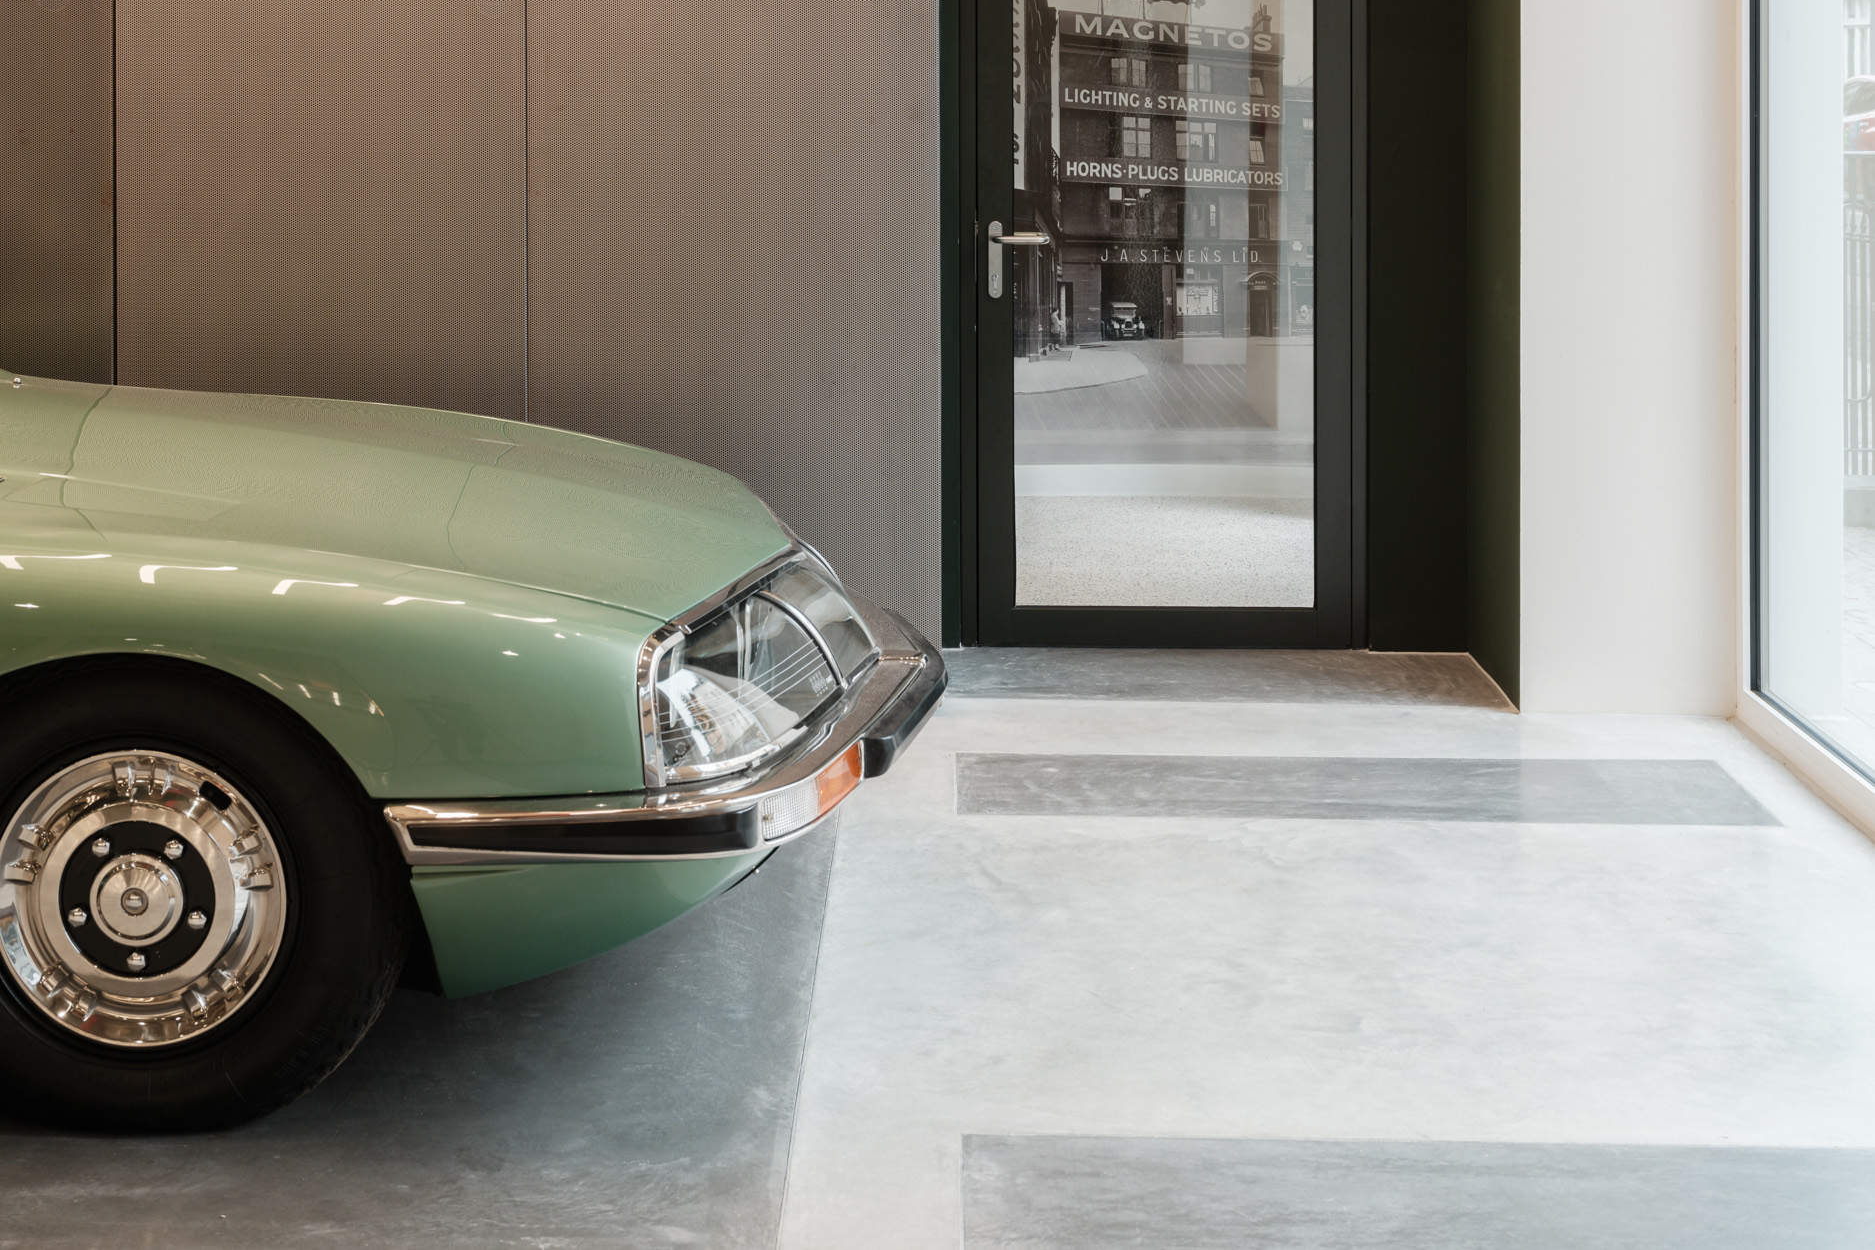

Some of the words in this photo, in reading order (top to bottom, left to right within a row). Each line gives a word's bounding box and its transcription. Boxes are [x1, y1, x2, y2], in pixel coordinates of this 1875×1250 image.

[1075, 14, 1273, 52] MAGNETOS
[1064, 87, 1140, 108] LIGHTING
[1144, 96, 1153, 109] &
[1157, 95, 1237, 115] STARTING
[1241, 102, 1281, 119] SETS
[1184, 167, 1284, 186] LUBRICATORS
[1139, 249, 1222, 263] STEVENS
